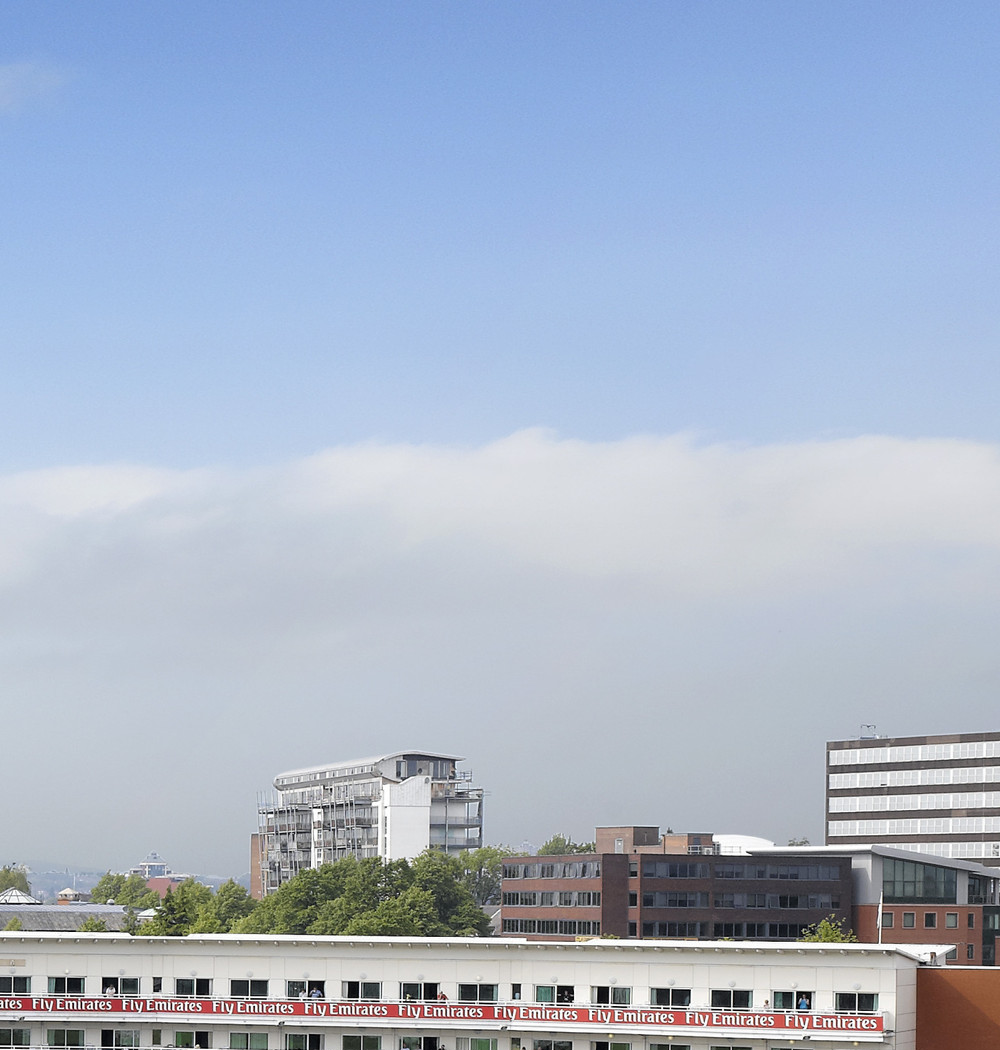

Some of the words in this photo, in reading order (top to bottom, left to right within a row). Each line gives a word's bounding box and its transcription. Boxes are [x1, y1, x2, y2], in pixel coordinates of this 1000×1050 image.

[32, 998, 53, 1012] Fly
[56, 999, 112, 1011] Emirates
[122, 1000, 143, 1013] Fly
[147, 1000, 202, 1012] Emirates
[212, 1001, 234, 1014] Fly
[237, 1001, 294, 1014] Emirates
[304, 1002, 326, 1016] Fly
[330, 1003, 388, 1016] Emirates
[398, 1005, 421, 1019] Fly
[424, 1006, 483, 1018] Emirates
[494, 1006, 516, 1021] Fly
[519, 1007, 578, 1020] Emirates
[588, 1009, 611, 1024] Fly
[614, 1010, 675, 1023] Emirates
[685, 1011, 709, 1026] Fly
[712, 1012, 775, 1026] Emirates
[785, 1014, 809, 1030] Fly
[812, 1016, 877, 1029] Emirates
